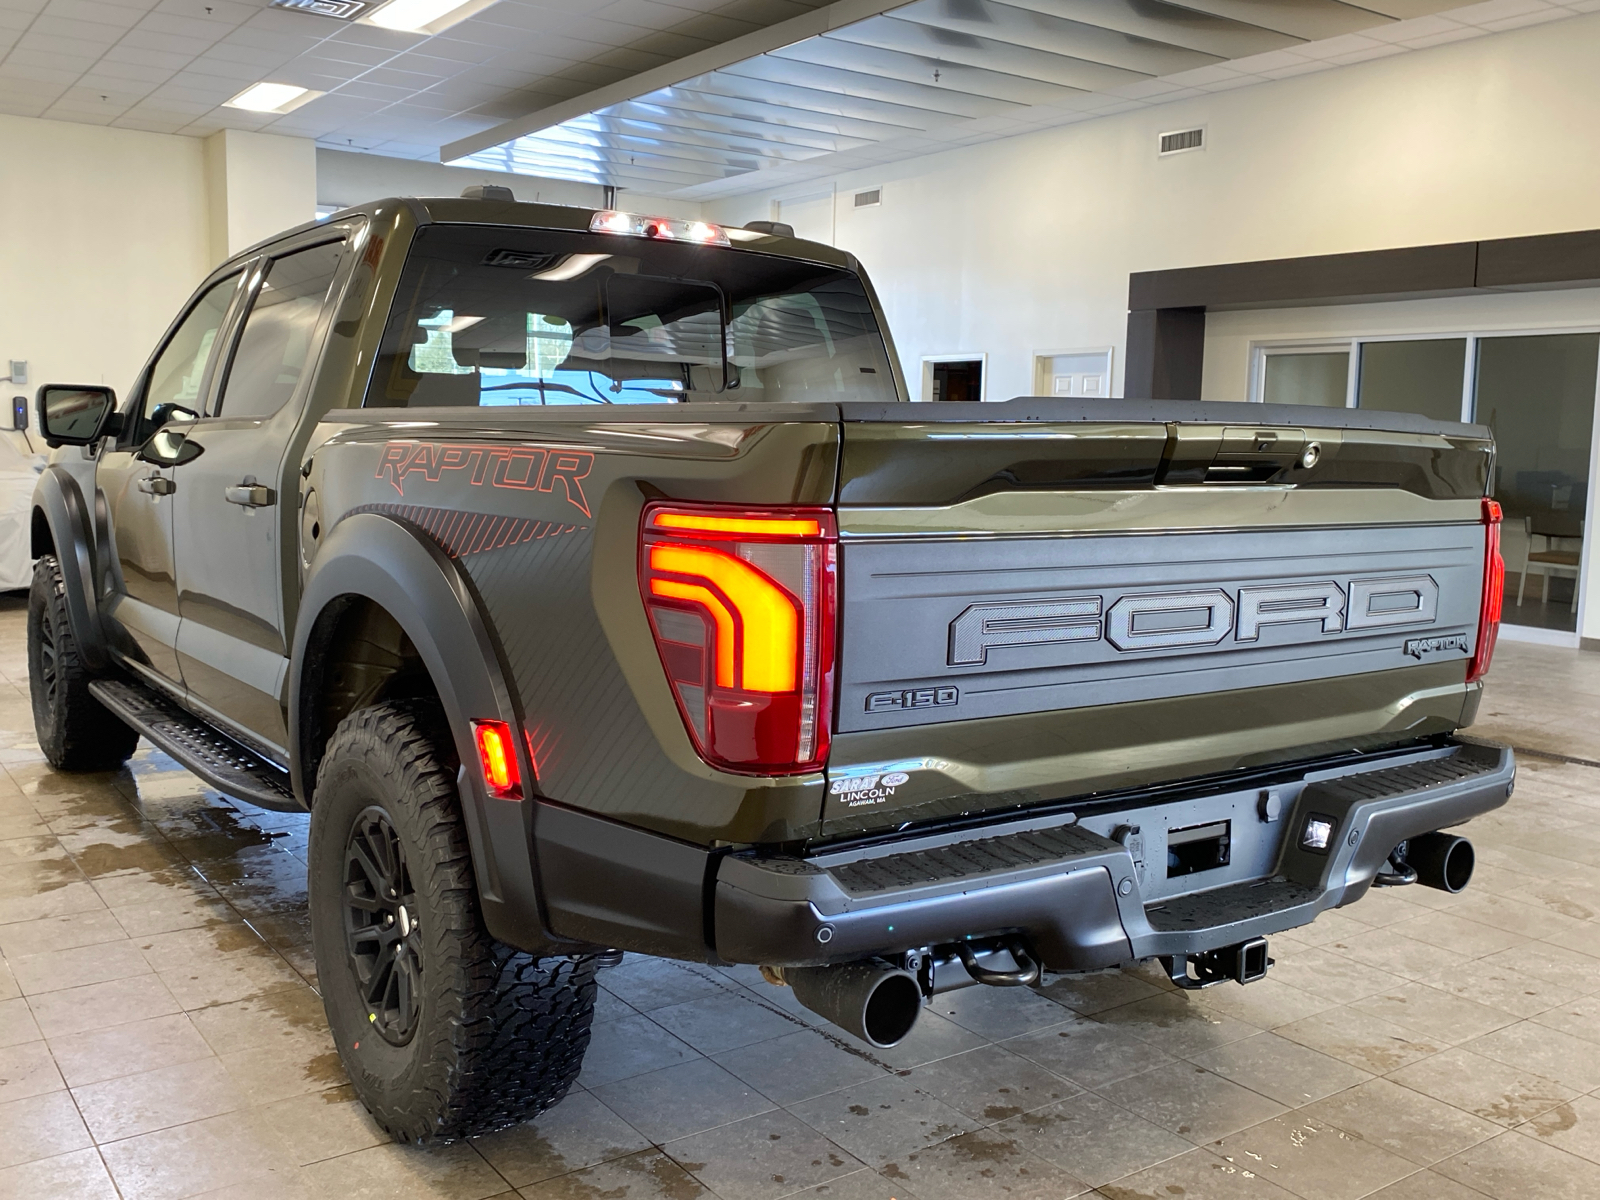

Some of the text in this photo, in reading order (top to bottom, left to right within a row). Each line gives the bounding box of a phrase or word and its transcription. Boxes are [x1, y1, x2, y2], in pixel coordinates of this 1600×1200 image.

[374, 442, 595, 519] RAPTOR
[946, 573, 1440, 667] FORD
[1403, 632, 1469, 660] RAPTOR
[864, 685, 959, 714] F-150
[830, 775, 880, 794] SARAT
[840, 787, 895, 802] LINCOLN
